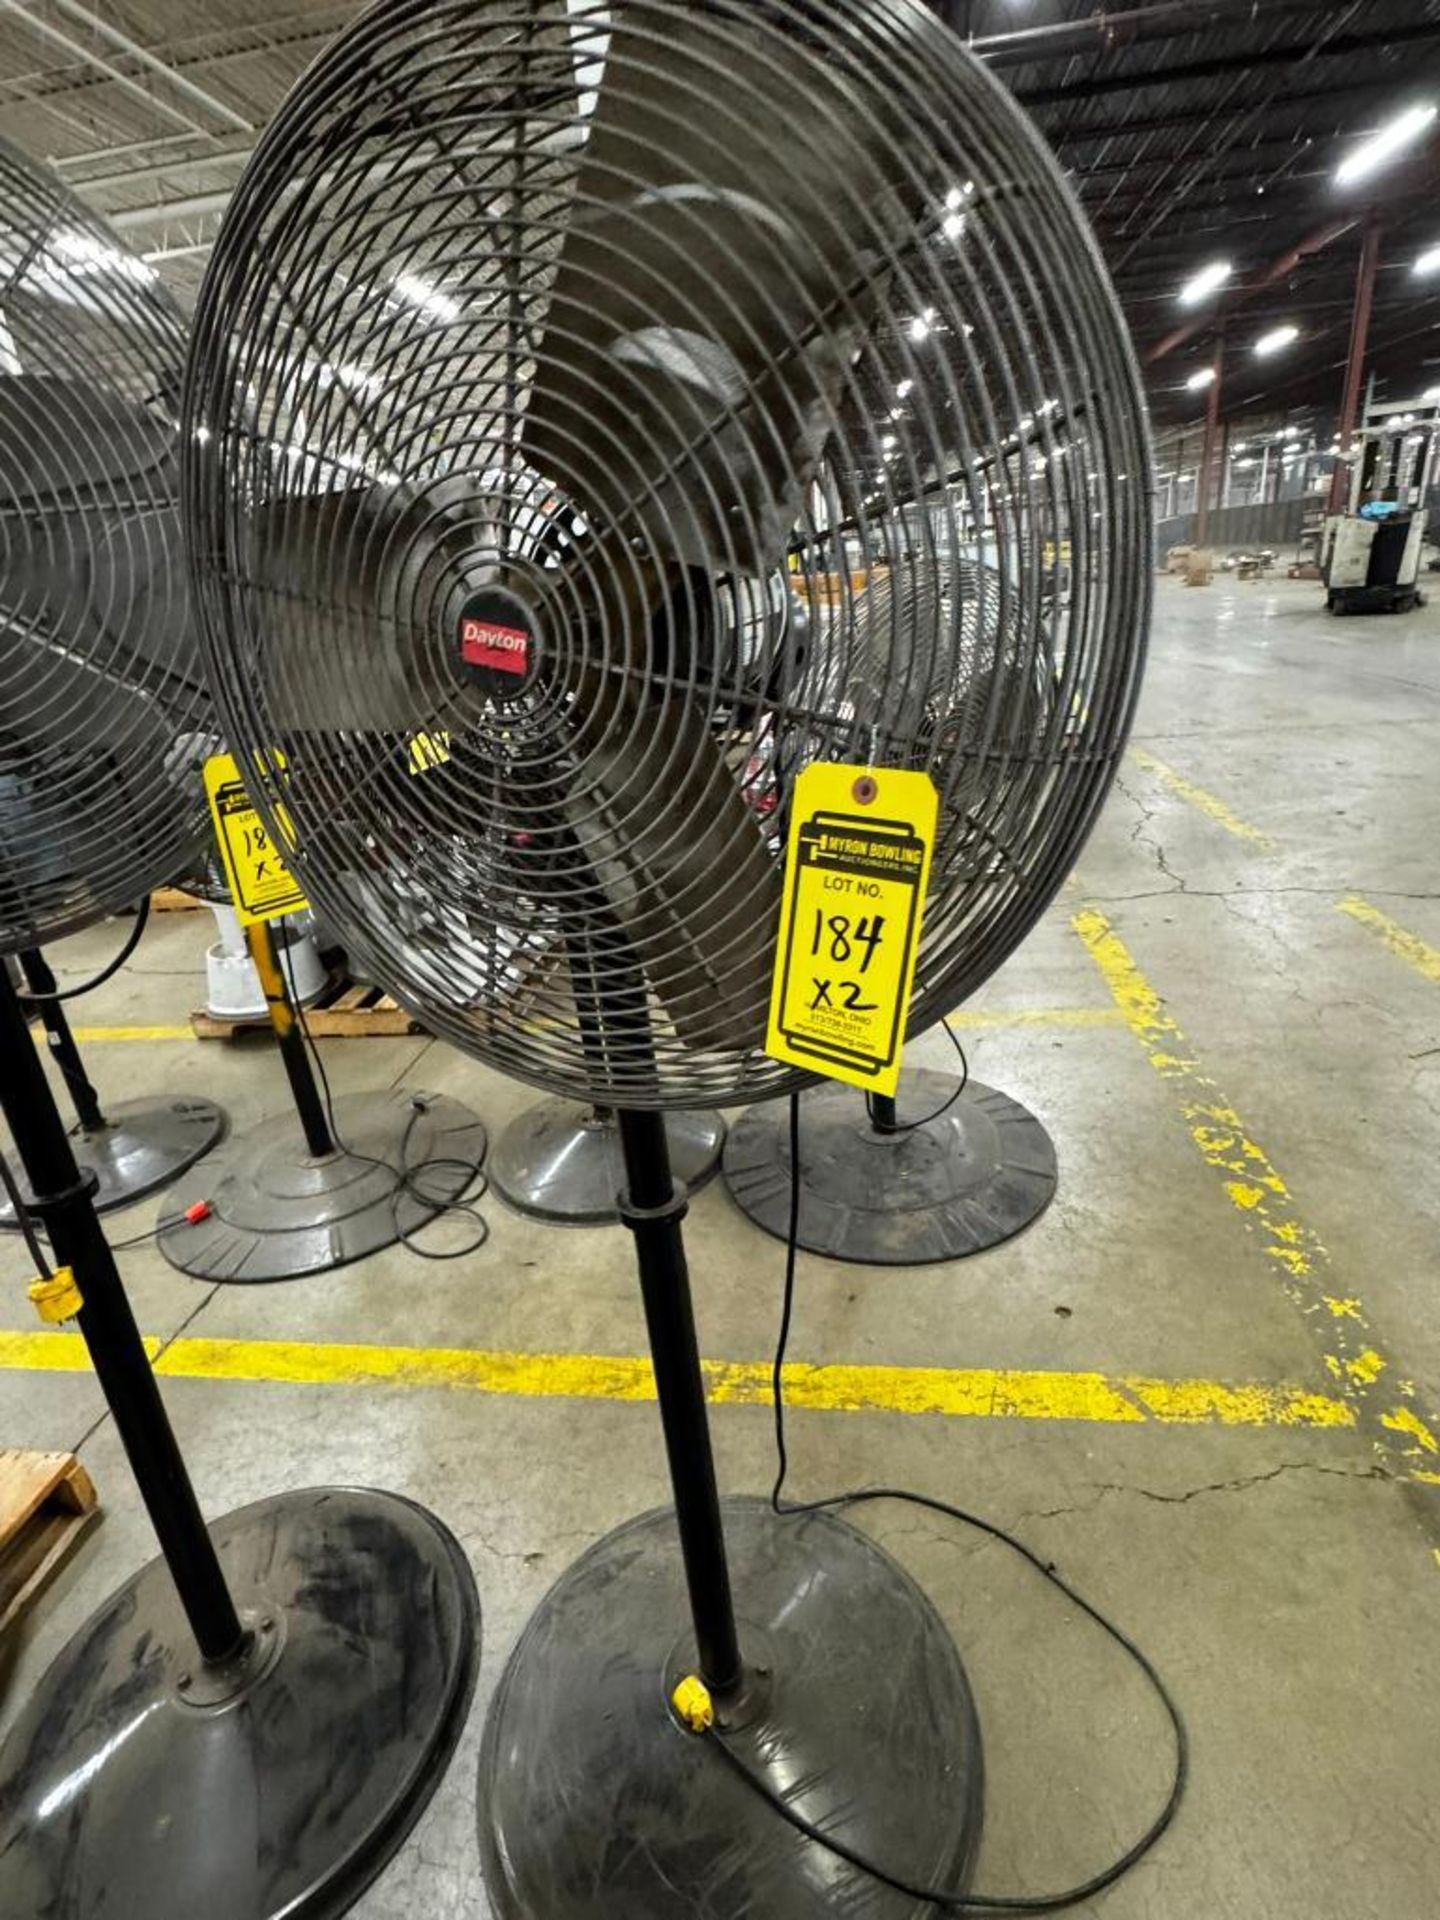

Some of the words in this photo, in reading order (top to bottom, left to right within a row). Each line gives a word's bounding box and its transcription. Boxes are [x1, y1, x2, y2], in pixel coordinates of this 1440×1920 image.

[463, 623, 527, 652] Dayton
[243, 827, 267, 857] 18
[828, 836, 867, 856] MYRON
[869, 842, 921, 864] BOWLING
[823, 875, 853, 892] LOT
[857, 881, 884, 898] NO.
[812, 908, 886, 973] 184
